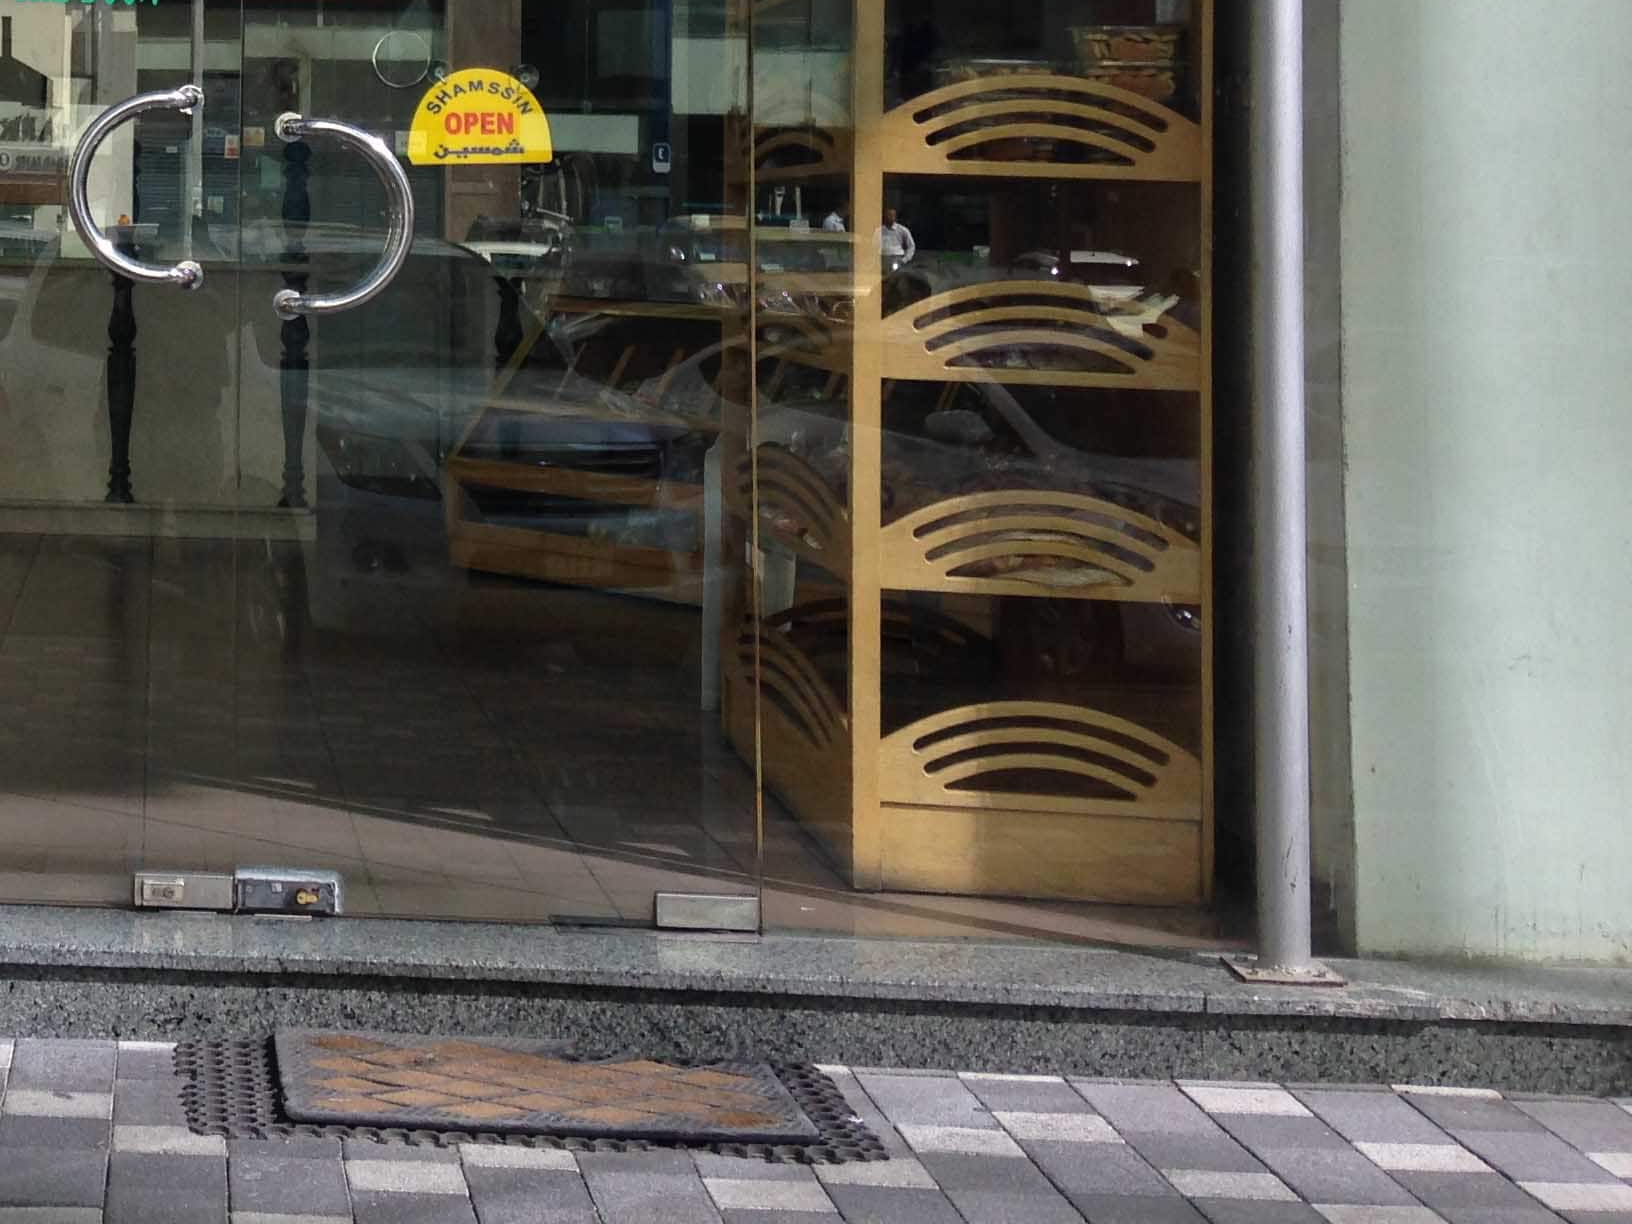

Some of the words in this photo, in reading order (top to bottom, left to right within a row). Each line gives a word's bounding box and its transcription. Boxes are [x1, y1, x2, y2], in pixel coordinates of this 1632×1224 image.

[426, 79, 534, 116] SHAMSSIN
[444, 112, 514, 135] OPEN
[433, 138, 525, 160] شمسين
